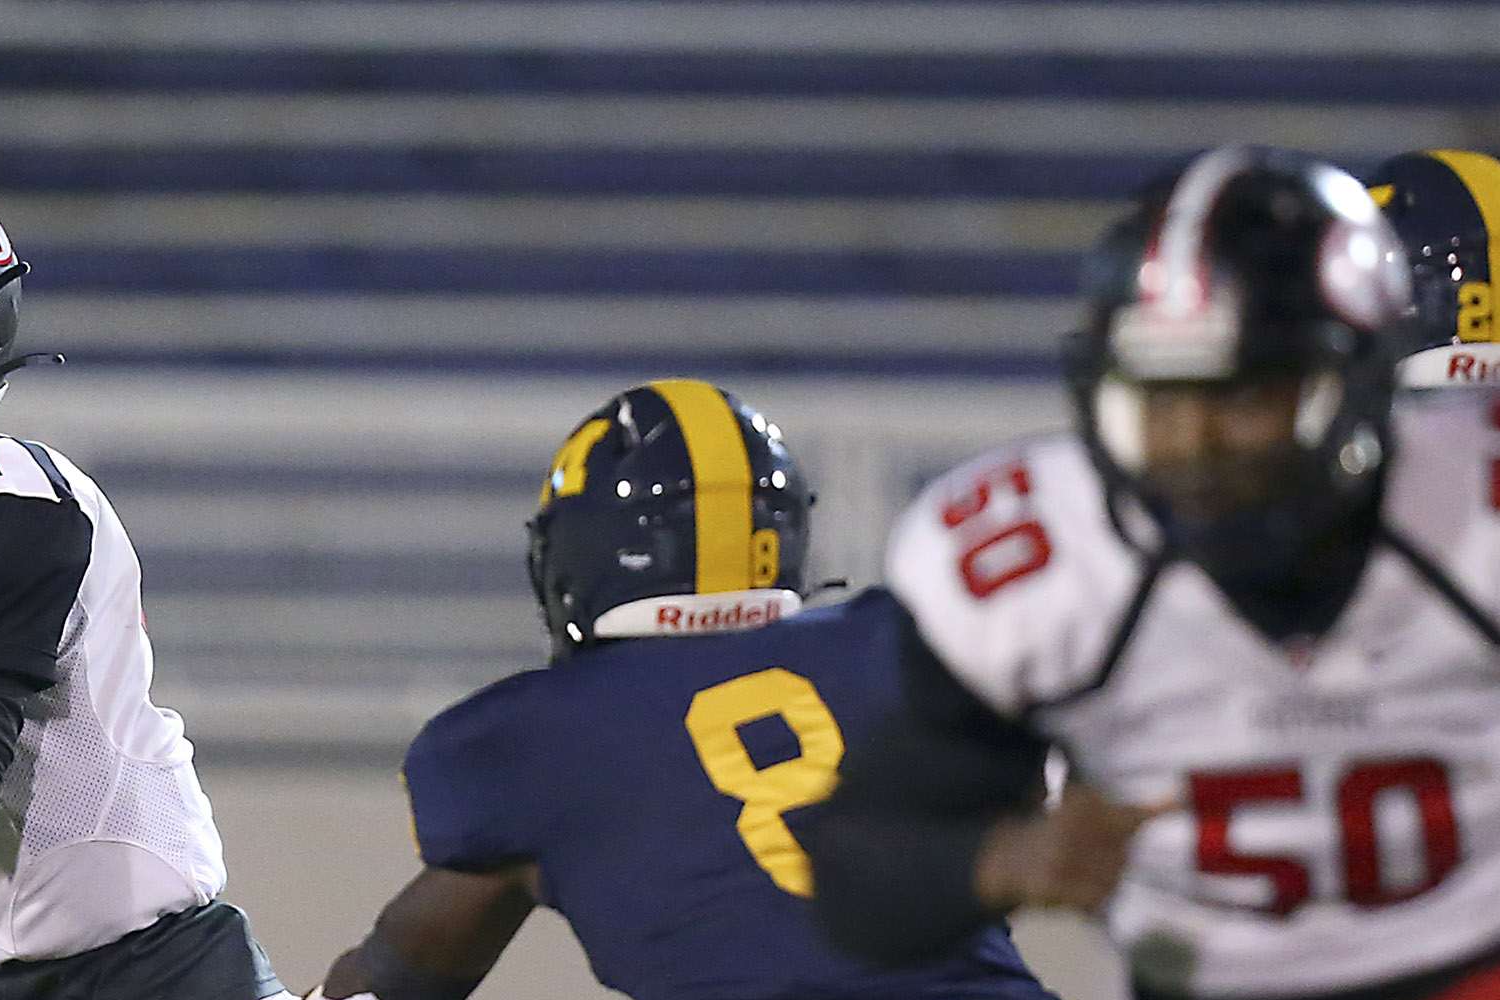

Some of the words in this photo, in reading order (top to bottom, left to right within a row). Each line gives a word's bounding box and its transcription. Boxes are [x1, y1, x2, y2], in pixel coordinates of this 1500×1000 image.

[941, 457, 1052, 599] 50
[656, 601, 782, 630] Riddell
[1186, 756, 1465, 922] 50
